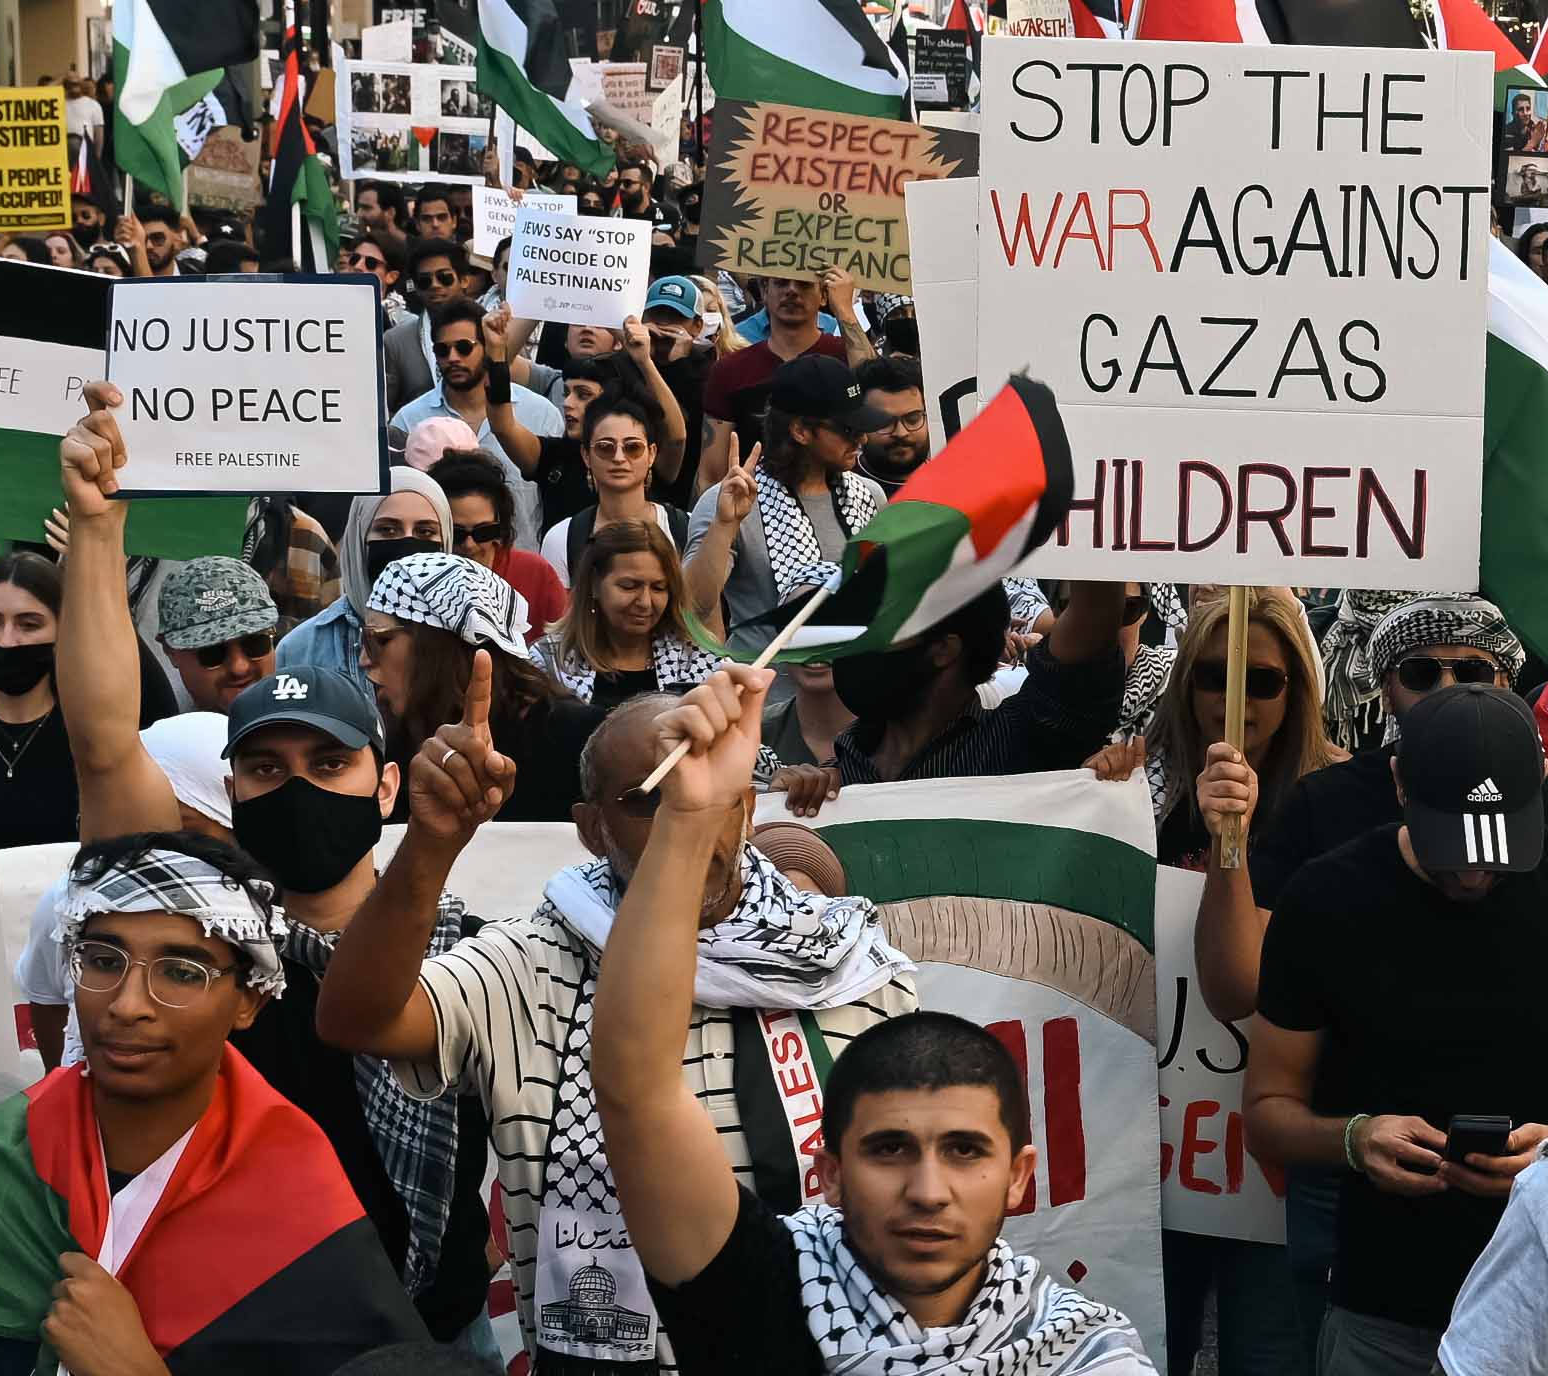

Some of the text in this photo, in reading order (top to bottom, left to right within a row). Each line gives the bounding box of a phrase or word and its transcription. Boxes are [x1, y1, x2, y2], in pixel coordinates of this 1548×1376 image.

[1008, 17, 1068, 38] NAZARETH
[1009, 60, 1209, 147] STOP
[1243, 69, 1426, 155] THE
[762, 111, 919, 160] RESPECT
[8, 167, 62, 186] PEOPLE
[484, 195, 509, 209] JEWS
[818, 191, 848, 214] OR
[522, 221, 551, 238] JEWS
[555, 226, 582, 242] SAY
[773, 208, 899, 247] EXPECT
[990, 184, 1489, 280] WAR AGAINST
[522, 245, 628, 269] GENOCIDE ON
[516, 267, 630, 293] PALESTINIANS”
[112, 317, 346, 354] NO JUSTICE
[1079, 312, 1387, 403] GAZAS
[132, 387, 196, 422] NO
[213, 387, 343, 423] PEACE
[175, 452, 300, 467] FREE PALESTINE
[1054, 458, 1427, 560] HILDREN
[272, 674, 309, 700] LA
[1466, 788, 1503, 804] adidas
